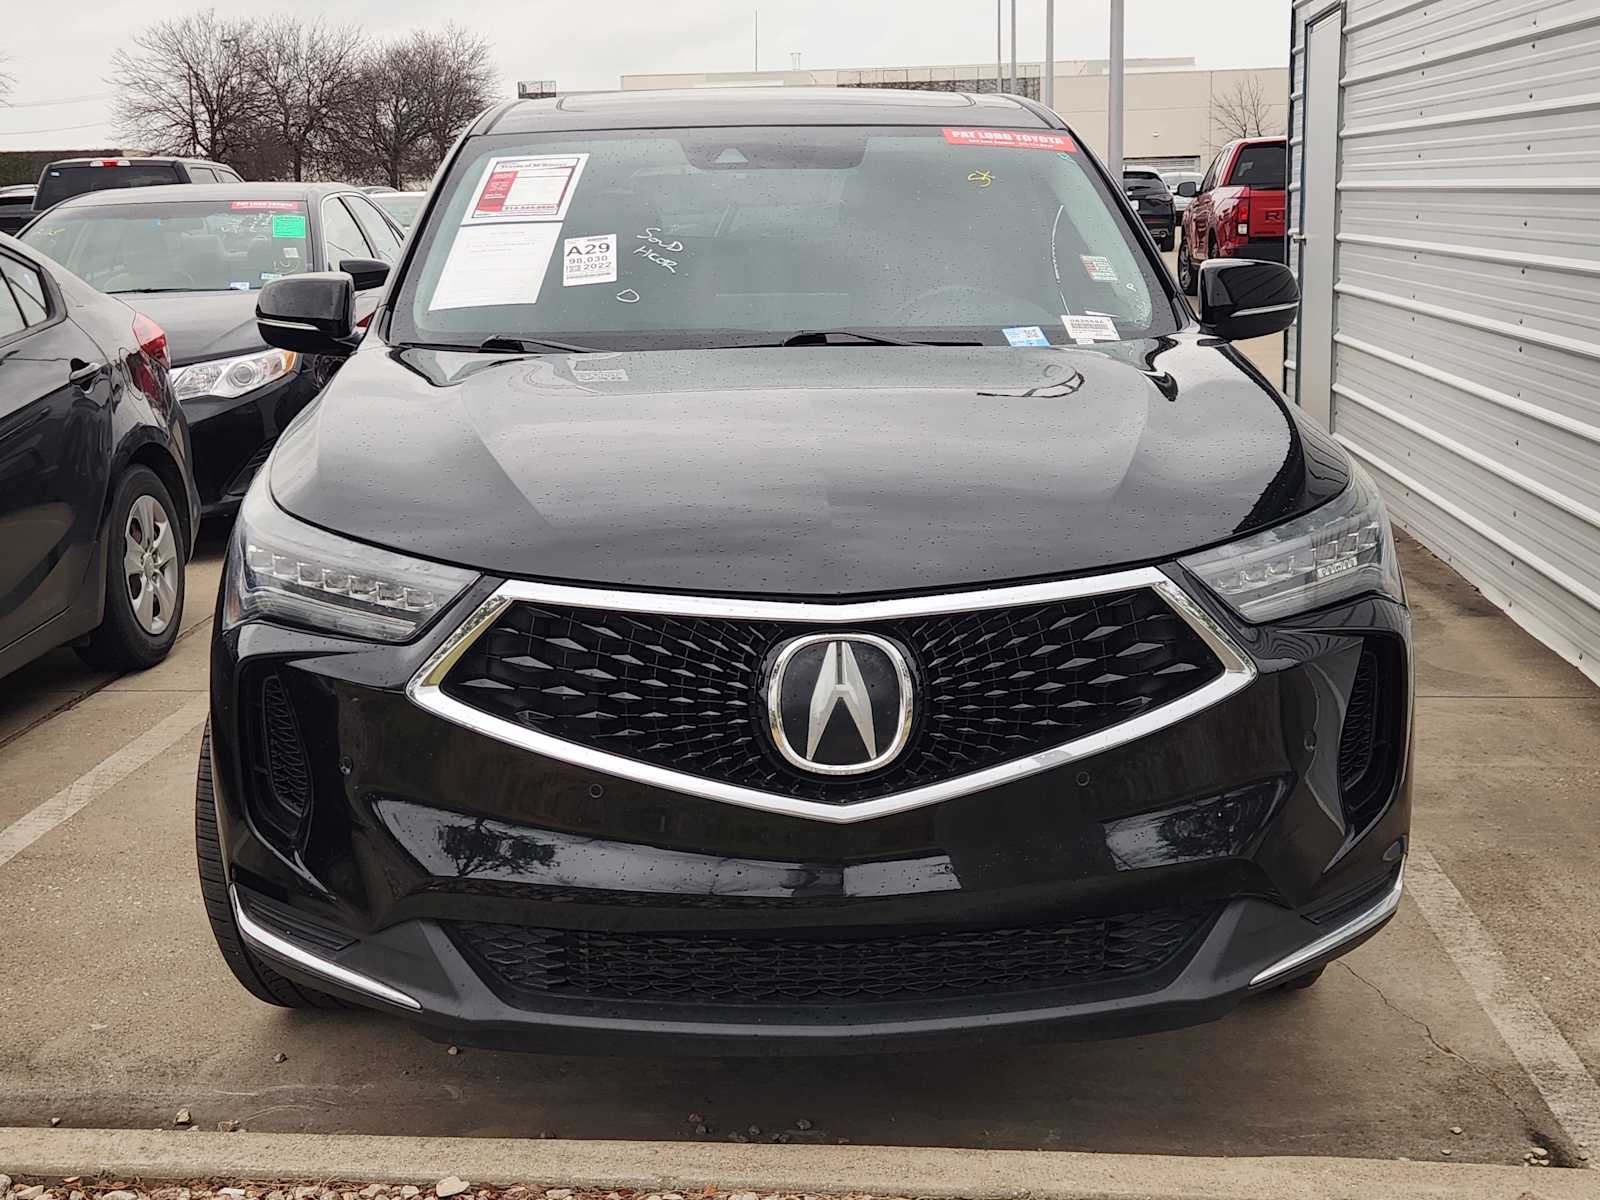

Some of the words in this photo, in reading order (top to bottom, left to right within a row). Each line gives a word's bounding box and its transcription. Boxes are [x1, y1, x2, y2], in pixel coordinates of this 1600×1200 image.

[1015, 133, 1065, 145] TOYOTA
[566, 242, 611, 257] A29
[583, 261, 612, 271] 2022
